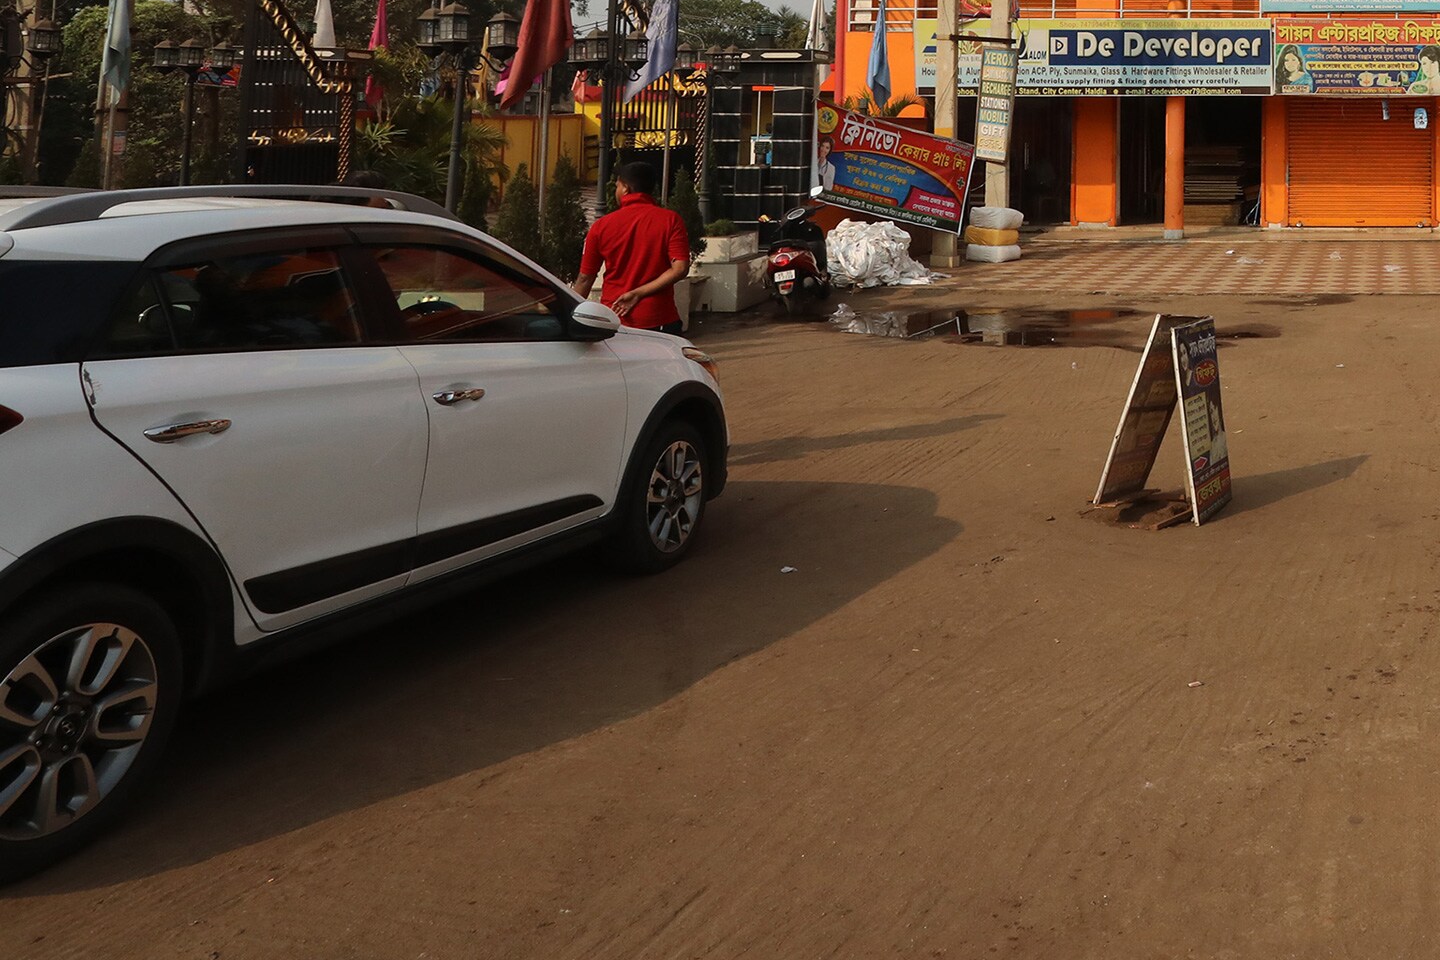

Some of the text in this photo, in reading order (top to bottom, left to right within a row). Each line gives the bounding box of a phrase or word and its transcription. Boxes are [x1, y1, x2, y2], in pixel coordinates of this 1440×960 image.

[1077, 31, 1261, 63] De Developer
[984, 51, 1014, 67] XEROX
[922, 67, 936, 76] Hou
[1101, 67, 1120, 76] Glass
[1122, 67, 1127, 76] &
[1131, 67, 1164, 76] Hardware
[1165, 67, 1191, 77] Fittings
[1193, 67, 1232, 76] Wholesaler
[1233, 67, 1239, 76] &
[1240, 67, 1267, 76] Retailer
[981, 82, 1012, 96] RECHARGE
[1018, 87, 1042, 95] Stand,
[1042, 87, 1056, 95] City
[1058, 87, 1083, 95] Center,
[1085, 87, 1107, 95] Haldia
[1125, 87, 1146, 95] e-mail
[979, 111, 1008, 123] MOBILE
[980, 124, 1005, 137] GIFT
